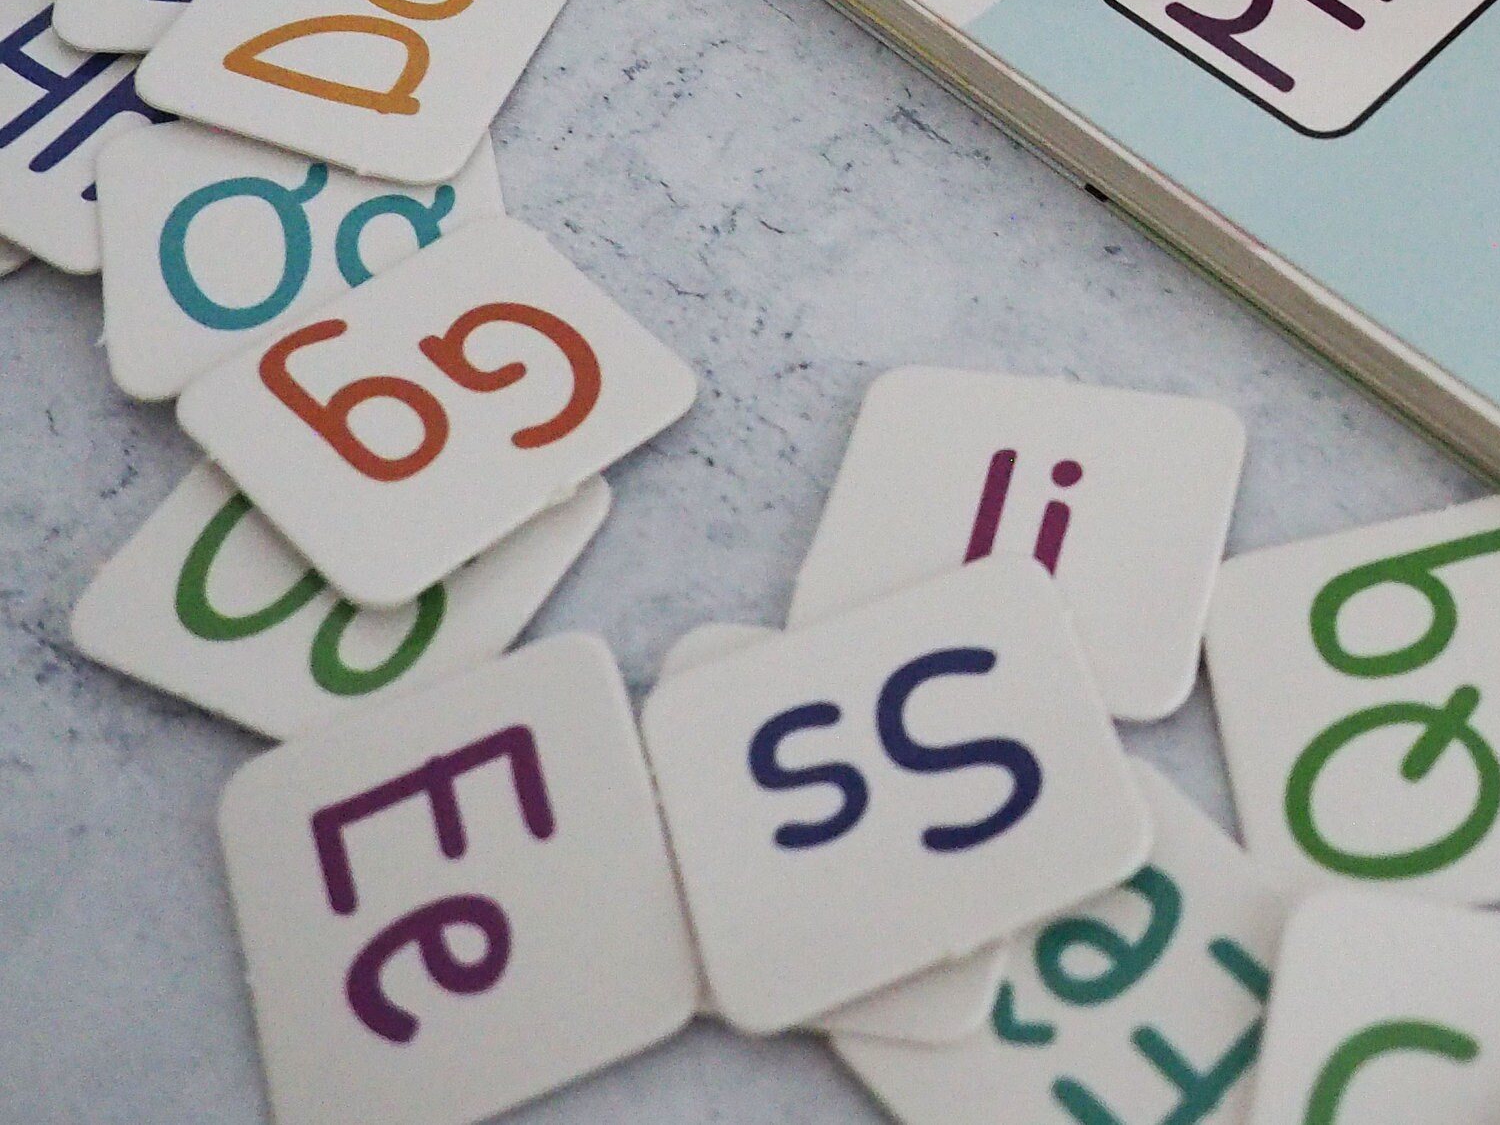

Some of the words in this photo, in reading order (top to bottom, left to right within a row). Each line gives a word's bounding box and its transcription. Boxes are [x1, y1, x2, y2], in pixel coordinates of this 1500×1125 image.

[258, 301, 602, 483] Gg
[747, 647, 1043, 852] Ss
[310, 723, 556, 1045] Ee
